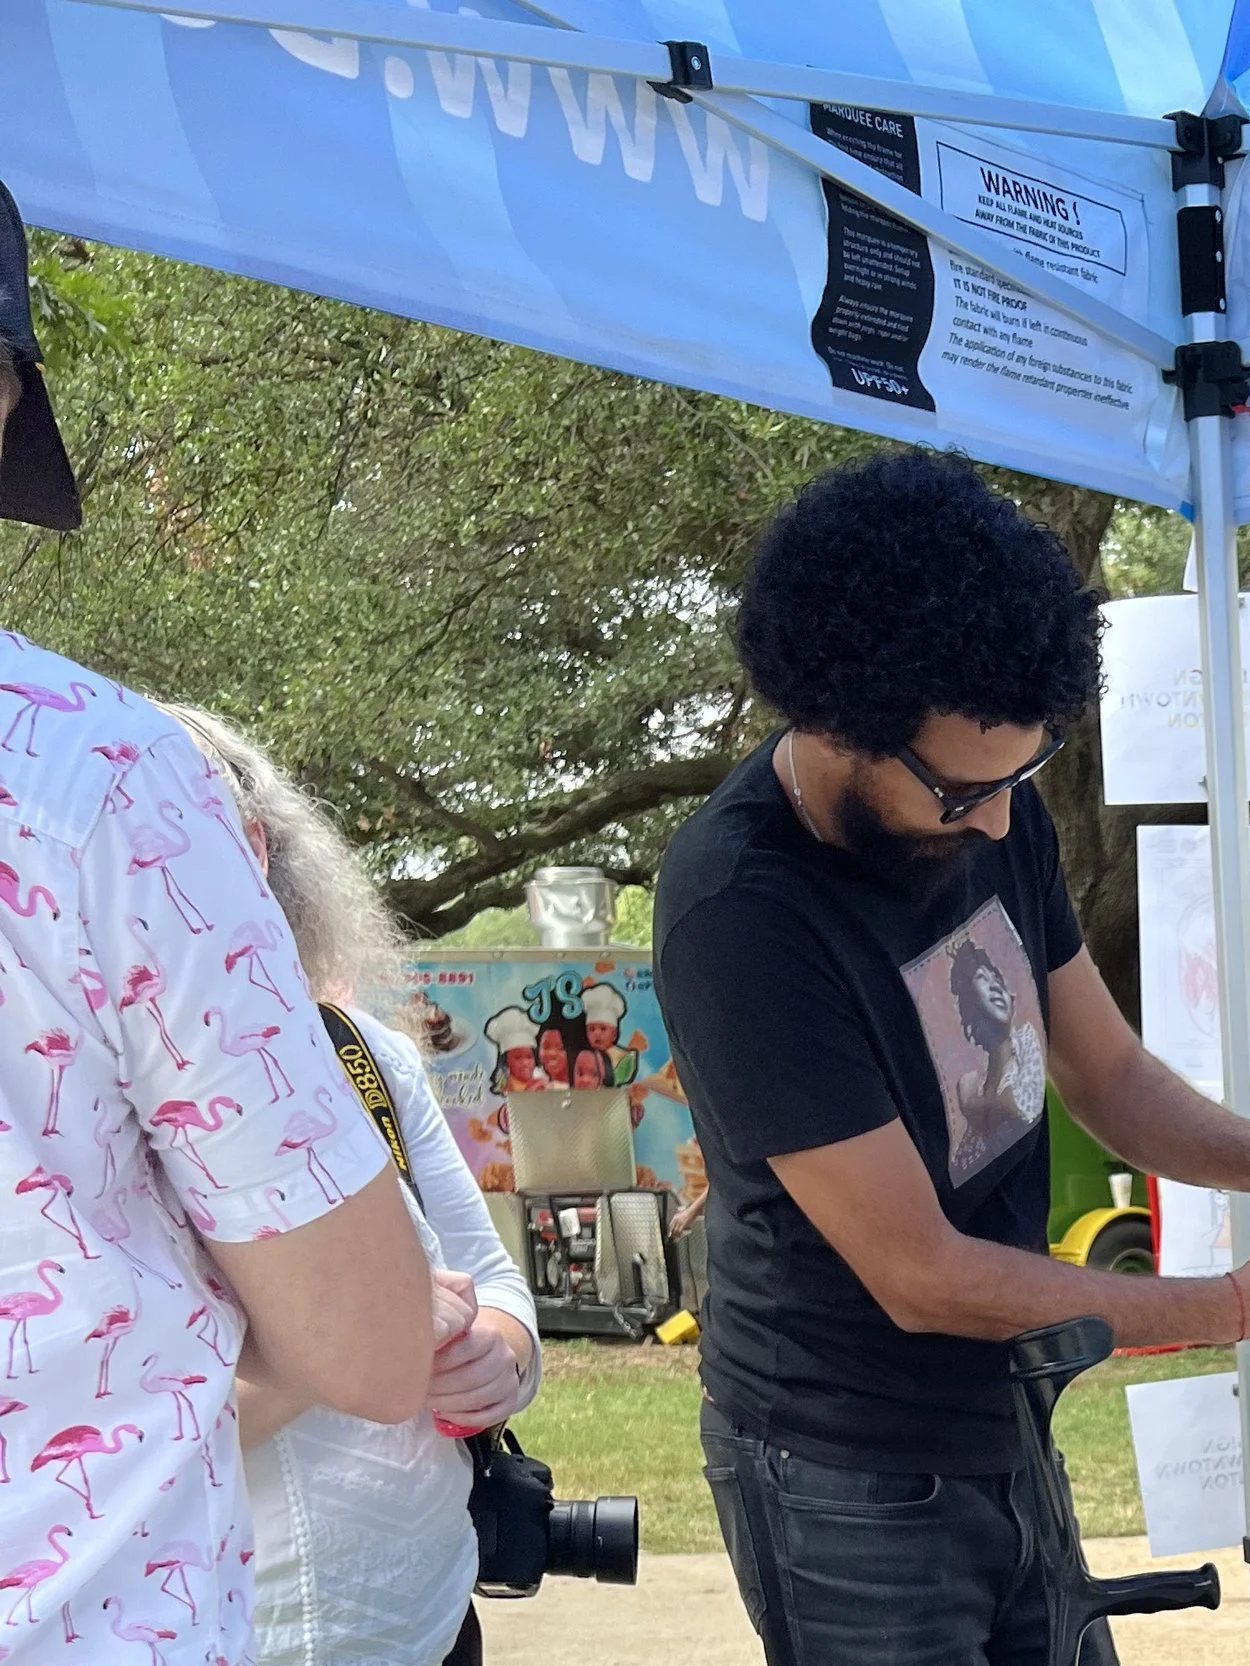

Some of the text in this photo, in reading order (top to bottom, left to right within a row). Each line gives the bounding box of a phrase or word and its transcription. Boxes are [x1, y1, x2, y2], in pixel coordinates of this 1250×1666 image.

[875, 117, 903, 138] CARE
[975, 209, 1048, 242] AWAY FROM THE FABRIC
[1008, 203, 1083, 240] FLAME AND HEAT SOURCES
[1025, 251, 1044, 268] flame
[1047, 260, 1079, 277] resistant
[971, 284, 1027, 311] NOT PROOF
[953, 317, 1033, 348] contact with flame
[1002, 311, 1088, 347] burn continuous
[941, 350, 1054, 390] may render flame retardant
[950, 332, 1092, 384] The application foreign substances
[851, 367, 910, 396] UPF50+
[339, 1044, 388, 1110] D850
